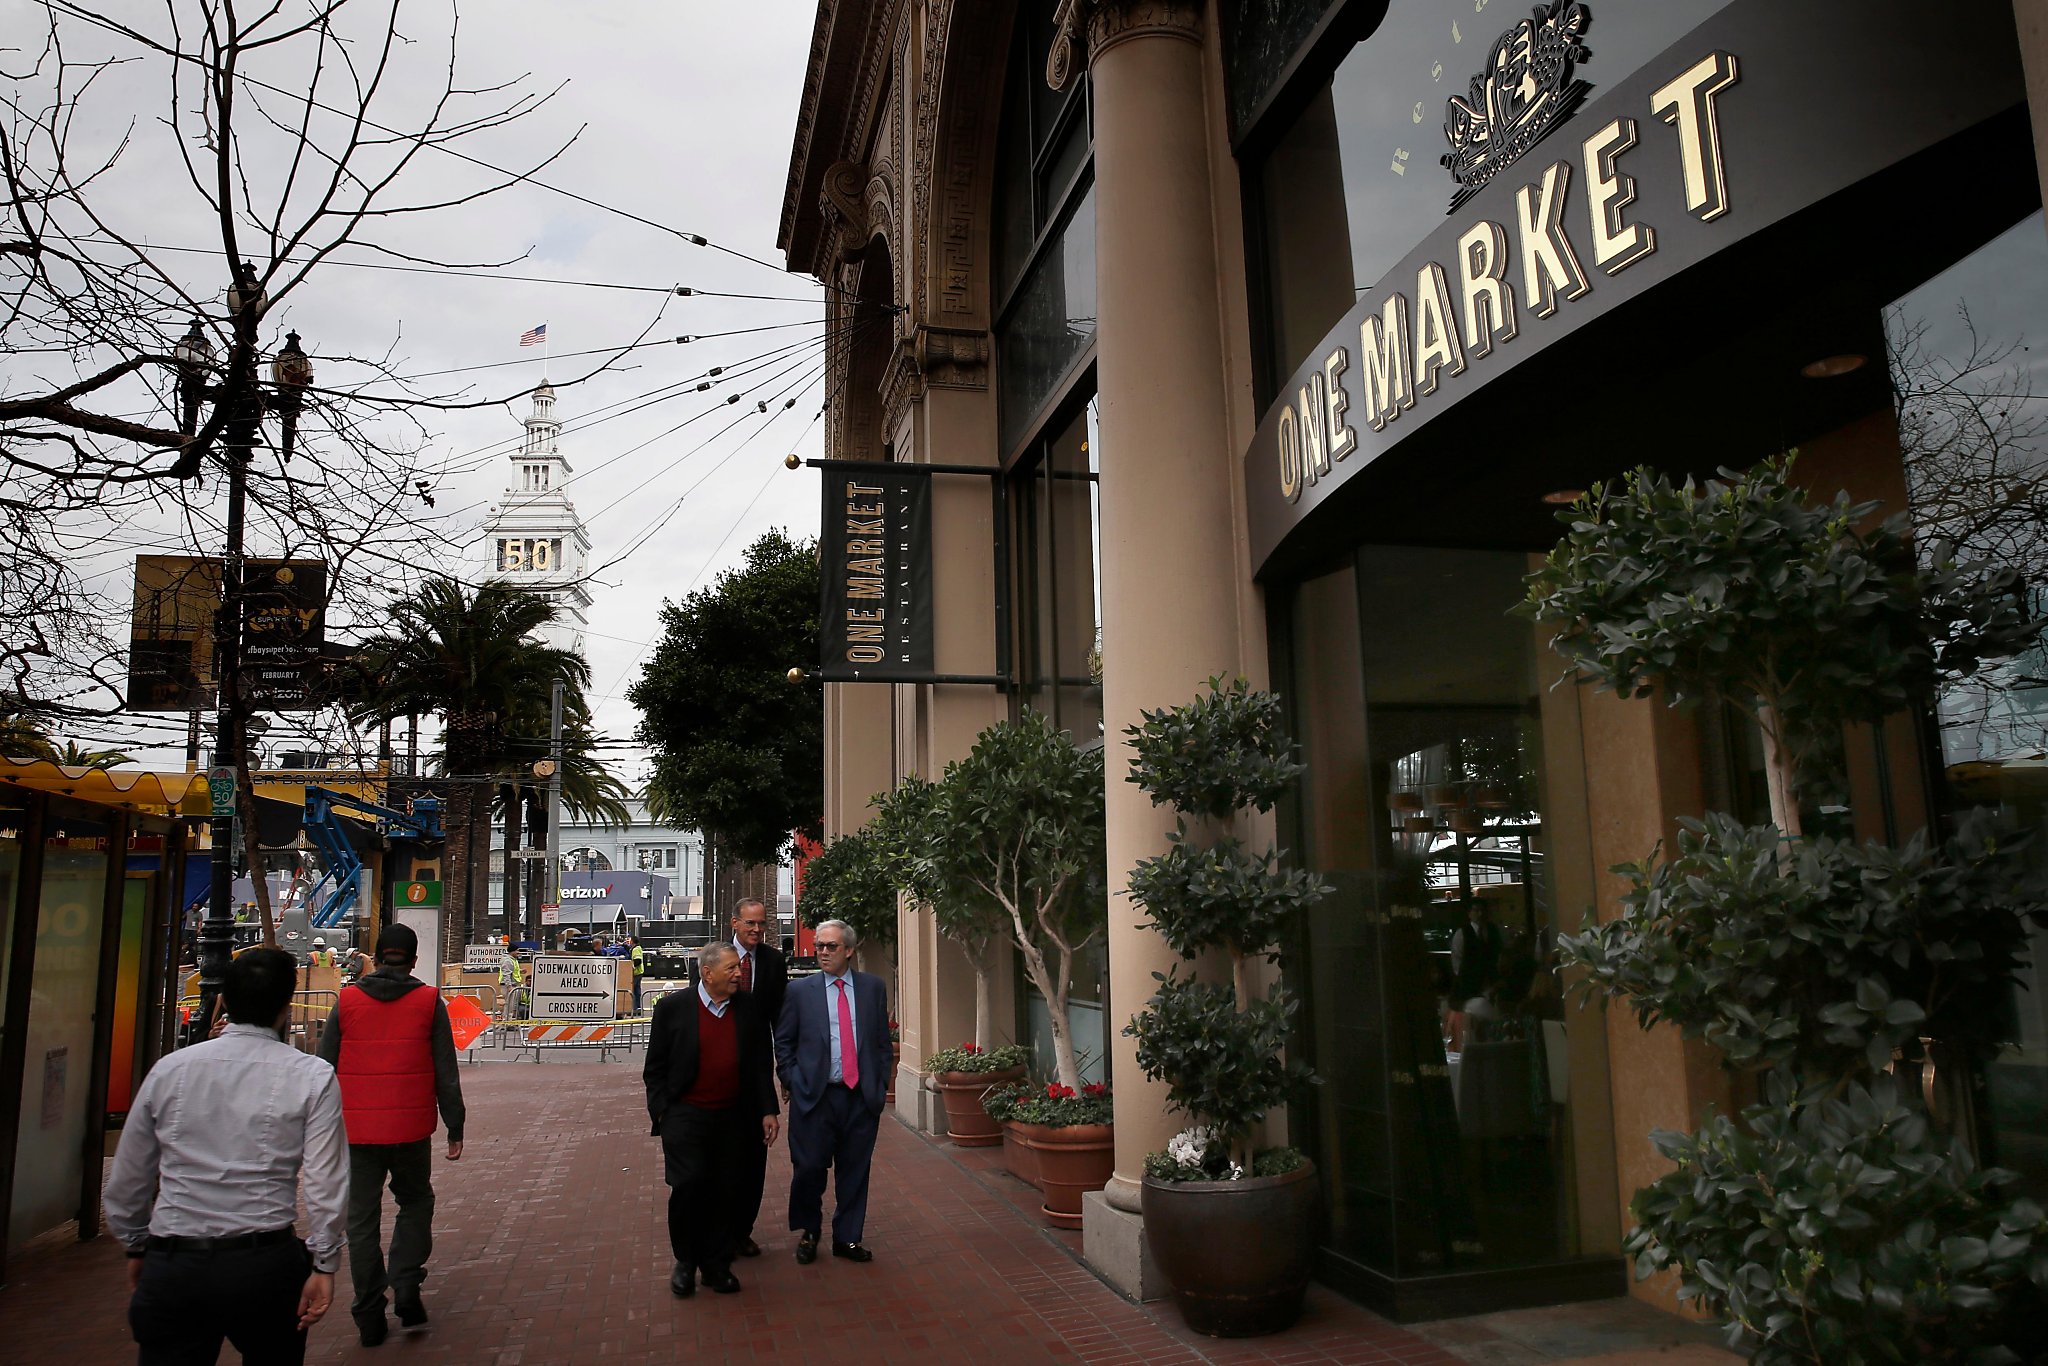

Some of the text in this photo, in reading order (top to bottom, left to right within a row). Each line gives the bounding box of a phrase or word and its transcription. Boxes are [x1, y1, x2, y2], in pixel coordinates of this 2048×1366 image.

[1277, 48, 1741, 504] ONE MARKET
[504, 540, 552, 570] 50
[846, 481, 885, 663] ONE MARKET
[900, 485, 910, 663] RESTAURANT
[262, 671, 301, 679] FEBRUARY 7
[213, 791, 230, 803] 50
[469, 948, 507, 956] AUTHORIZED
[538, 963, 613, 975] SIDEWALK CLOSED
[560, 977, 589, 988] AHEAD
[548, 1002, 599, 1013] CROSS HERE
[450, 1017, 481, 1027] TOUR
